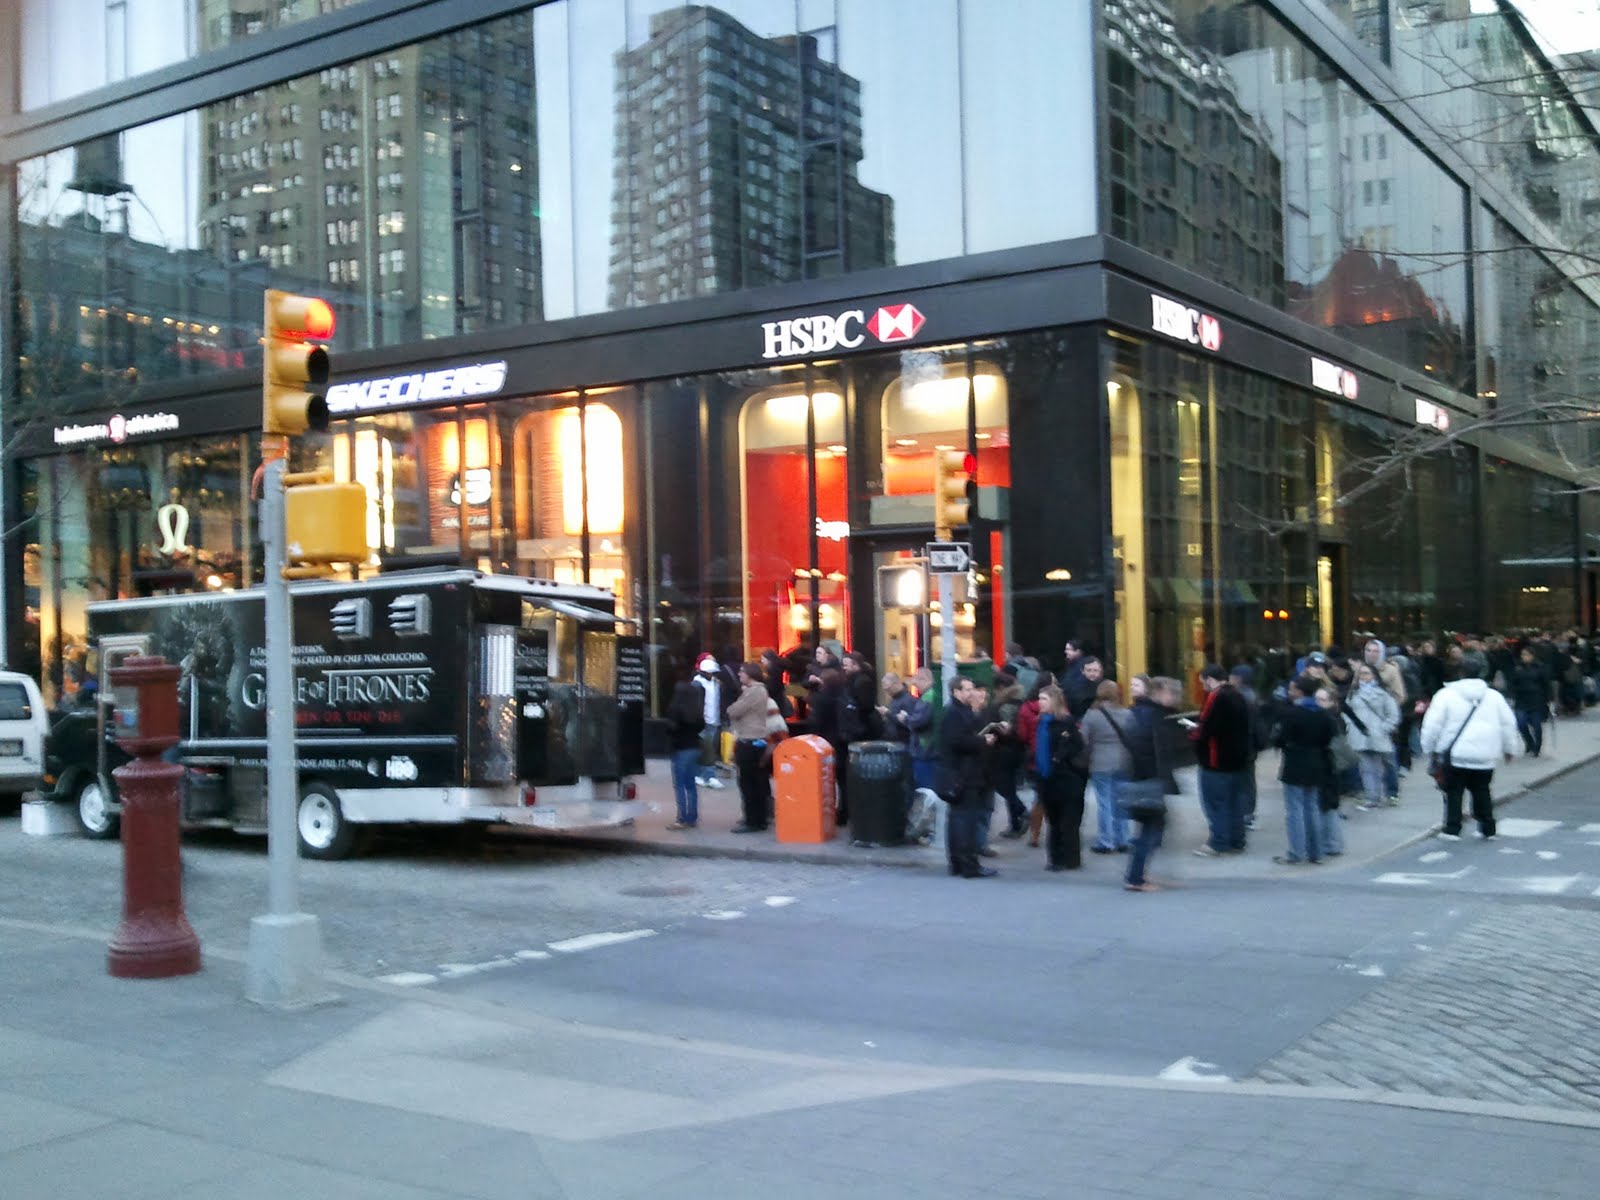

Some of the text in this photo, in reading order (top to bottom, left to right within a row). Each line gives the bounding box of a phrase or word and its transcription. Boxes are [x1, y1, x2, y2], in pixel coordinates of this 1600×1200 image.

[761, 310, 865, 358] HSBC
[325, 360, 507, 412] SKECHERS
[364, 654, 380, 662] TOM
[308, 681, 326, 699] OF
[322, 667, 435, 707] THRONES
[386, 759, 418, 781] HBO
